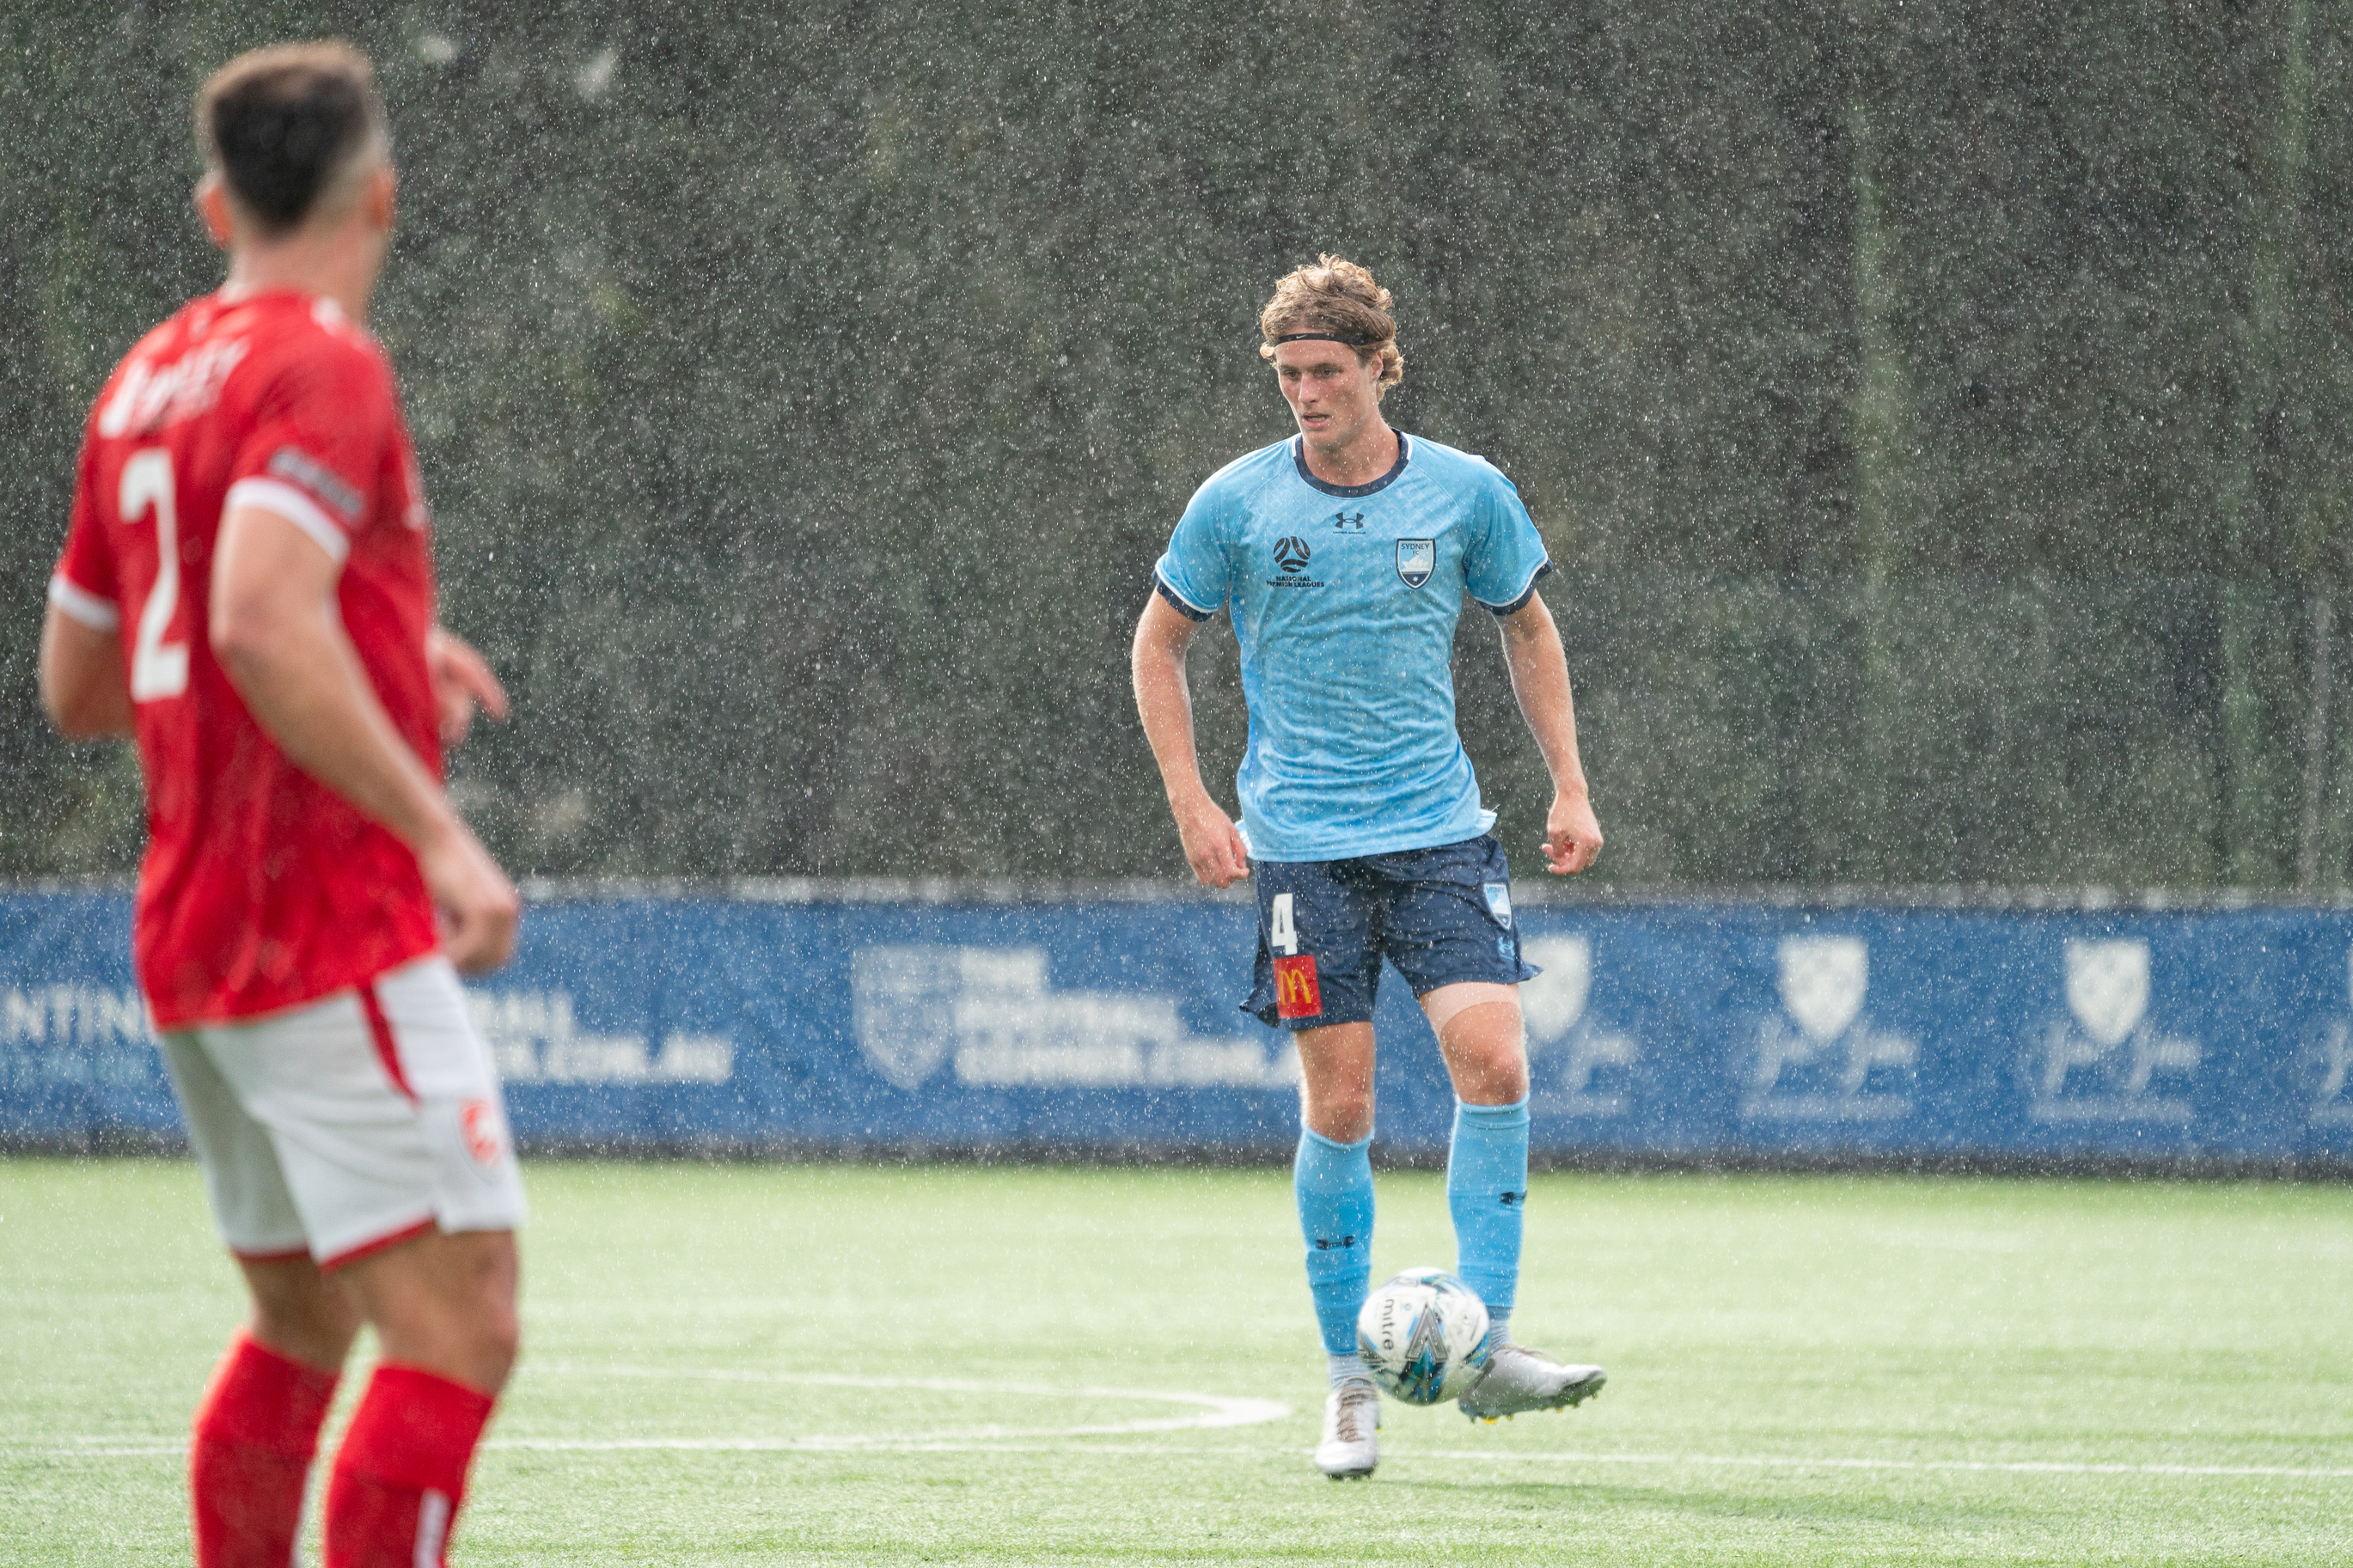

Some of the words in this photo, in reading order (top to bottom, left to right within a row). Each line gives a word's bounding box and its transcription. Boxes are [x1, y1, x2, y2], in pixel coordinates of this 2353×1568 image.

[119, 448, 189, 703] 2
[1272, 893, 1299, 956] 4
[1382, 1297, 1396, 1351] mitre
